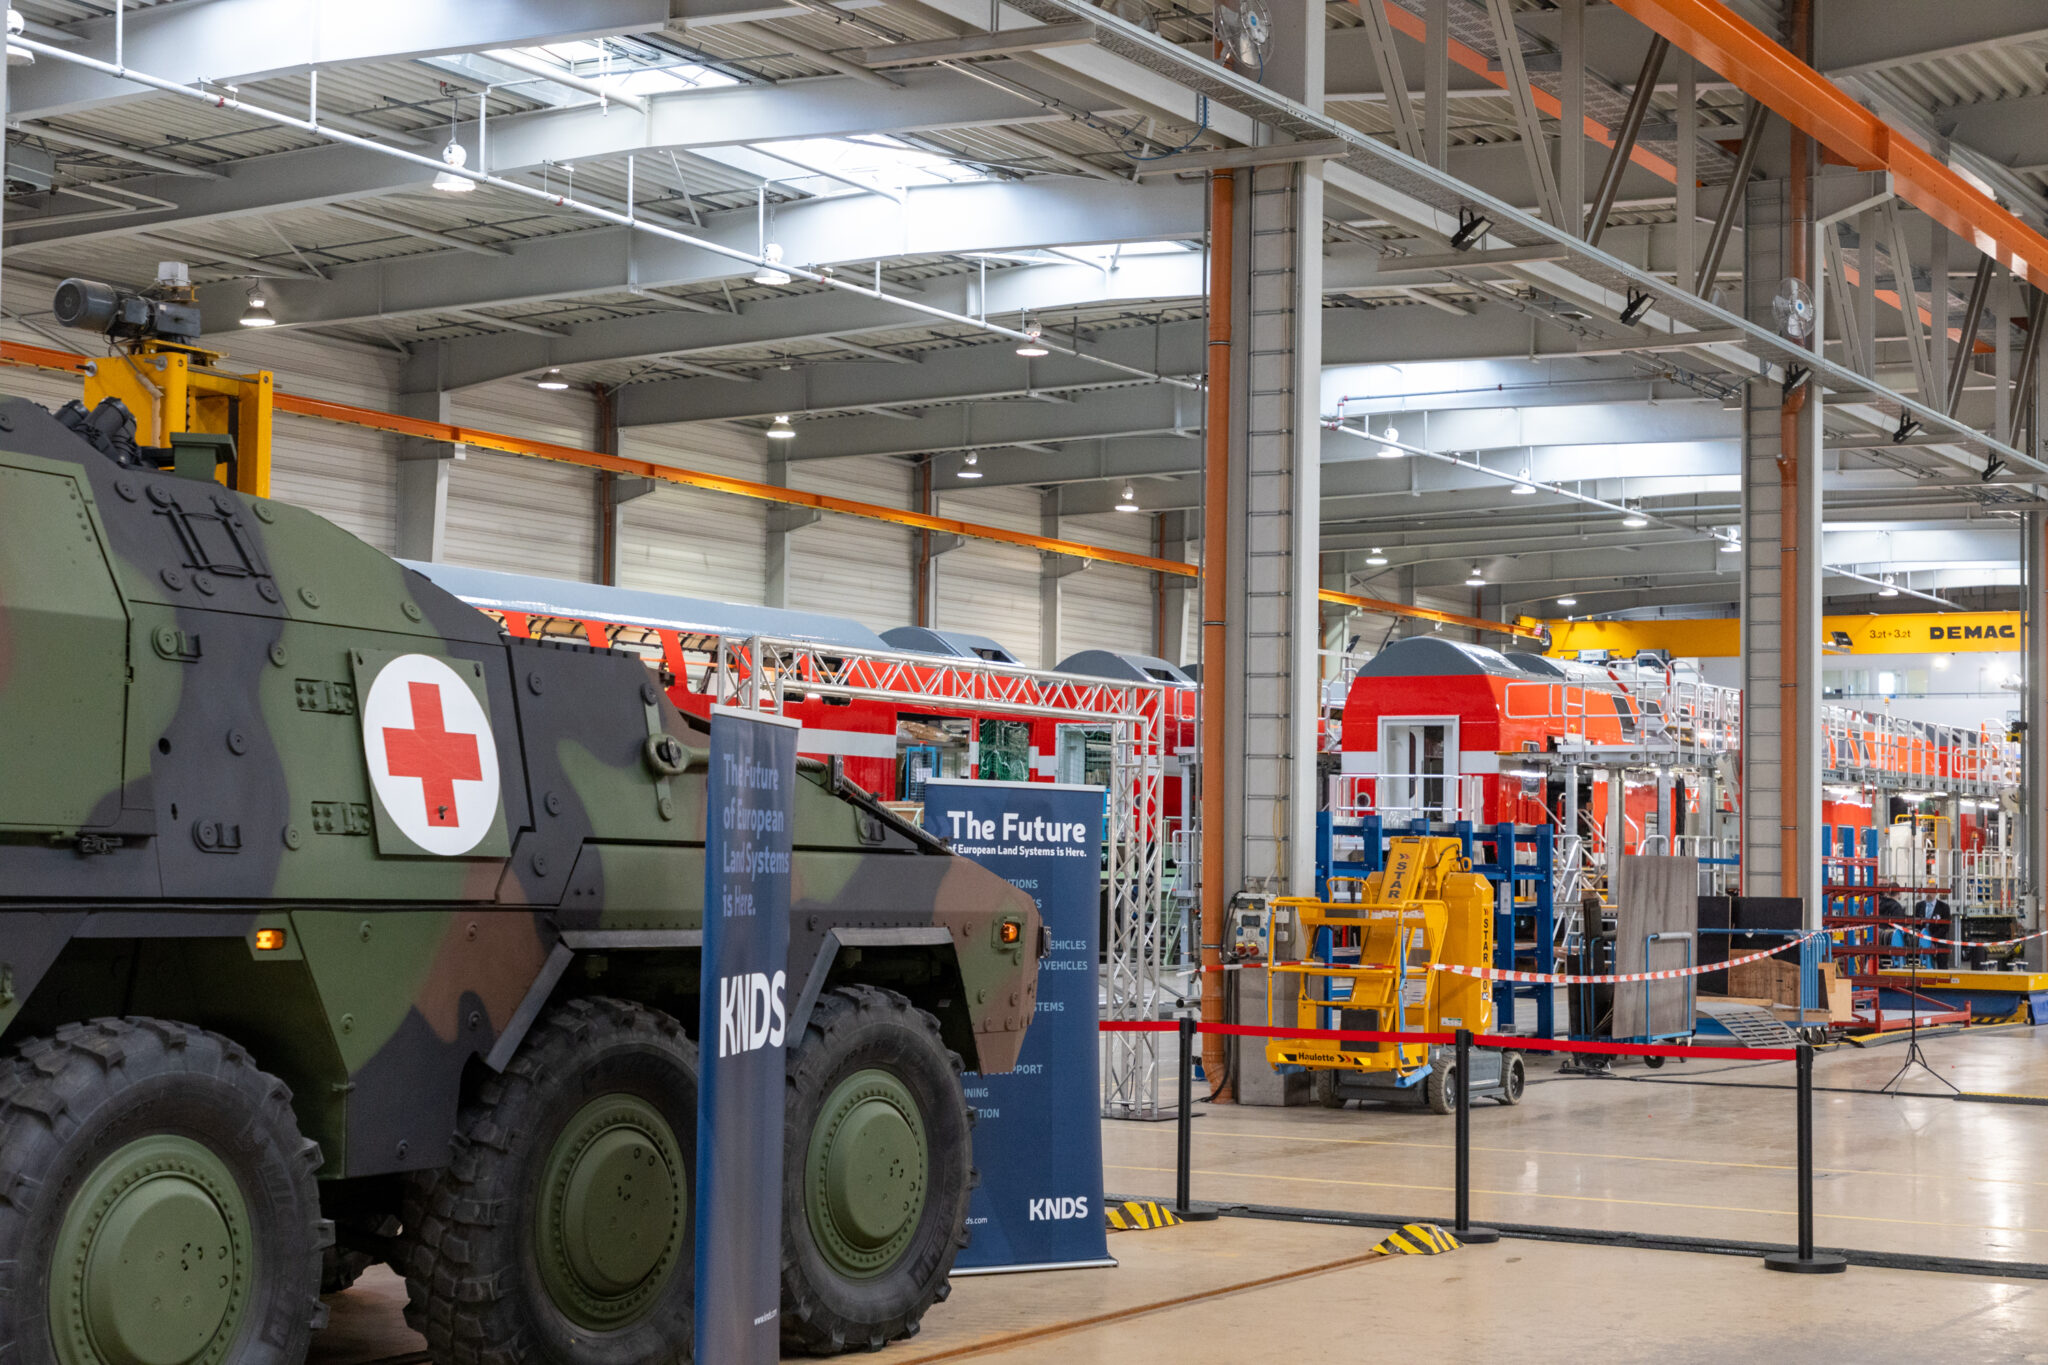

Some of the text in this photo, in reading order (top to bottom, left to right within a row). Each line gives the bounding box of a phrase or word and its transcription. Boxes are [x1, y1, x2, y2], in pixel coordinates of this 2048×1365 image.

[1930, 625, 2015, 640] DEMAG
[723, 753, 779, 791] The Future
[723, 797, 784, 840] of European
[947, 810, 1087, 844] The Future
[958, 844, 996, 857] European
[997, 845, 1018, 855] Land
[1018, 846, 1056, 858] Systems
[1056, 847, 1065, 857] is
[1065, 847, 1088, 857] Here.
[723, 841, 789, 882] Land Systems
[1006, 879, 1039, 889] TIONS
[1388, 862, 1407, 898] STAR
[723, 884, 756, 917] is Here.
[1050, 940, 1087, 950] EHICLES
[1482, 918, 1490, 963] STAR
[1045, 961, 1088, 970] VEHICLES
[719, 969, 787, 1059] KNDS
[1034, 1002, 1065, 1012] TEMS
[1298, 1052, 1335, 1062] Haulotte
[964, 1088, 989, 1098] INING
[1029, 1196, 1089, 1221] KNDS
[965, 1217, 988, 1225] ds.com
